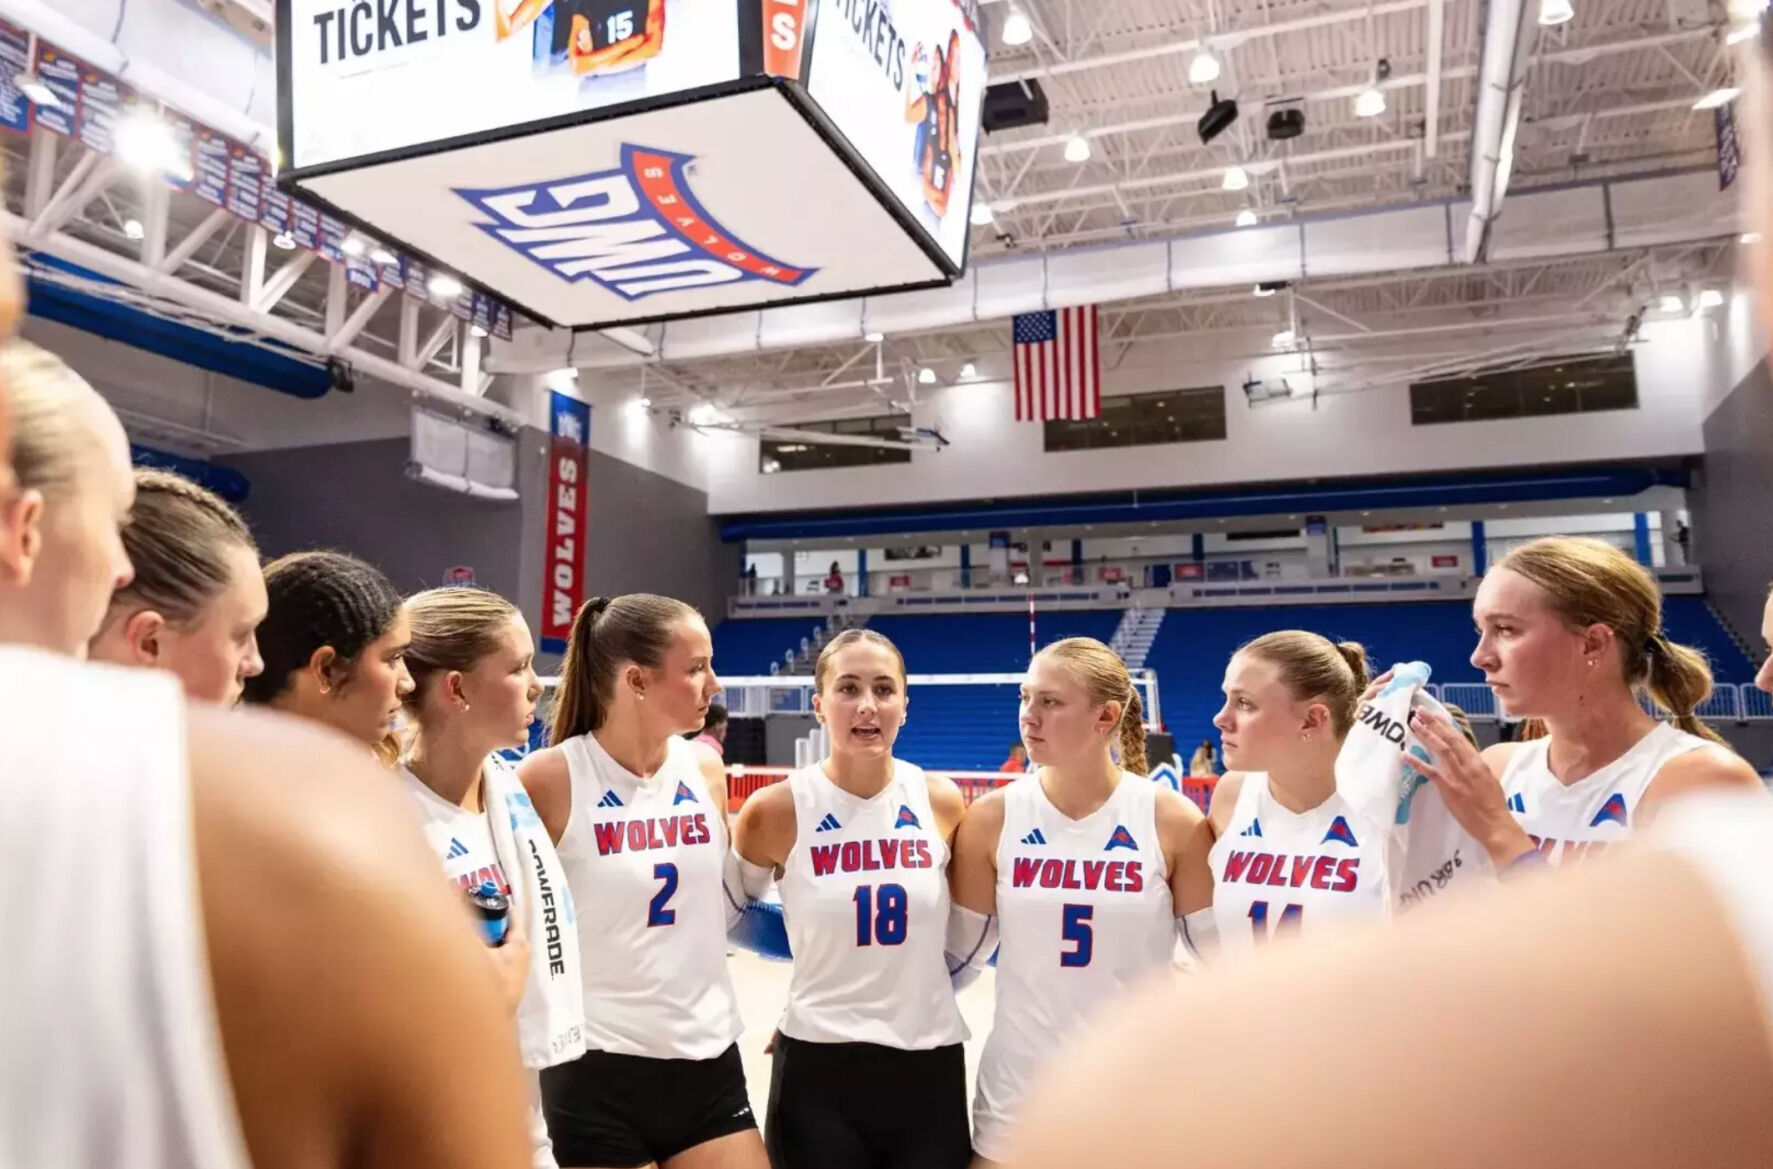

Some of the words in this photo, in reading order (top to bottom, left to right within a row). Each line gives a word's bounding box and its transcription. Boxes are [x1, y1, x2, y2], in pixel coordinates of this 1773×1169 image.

[313, 0, 481, 64] TICKETS
[606, 11, 633, 43] 15
[553, 457, 578, 626] WOLVES
[594, 814, 710, 856] WOLVES
[810, 839, 932, 876] WOLVES
[647, 863, 679, 928] 2
[1013, 857, 1143, 893] WOLVES
[1223, 850, 1360, 893] WOLVES
[853, 883, 908, 947] 18
[1061, 903, 1093, 968] 5
